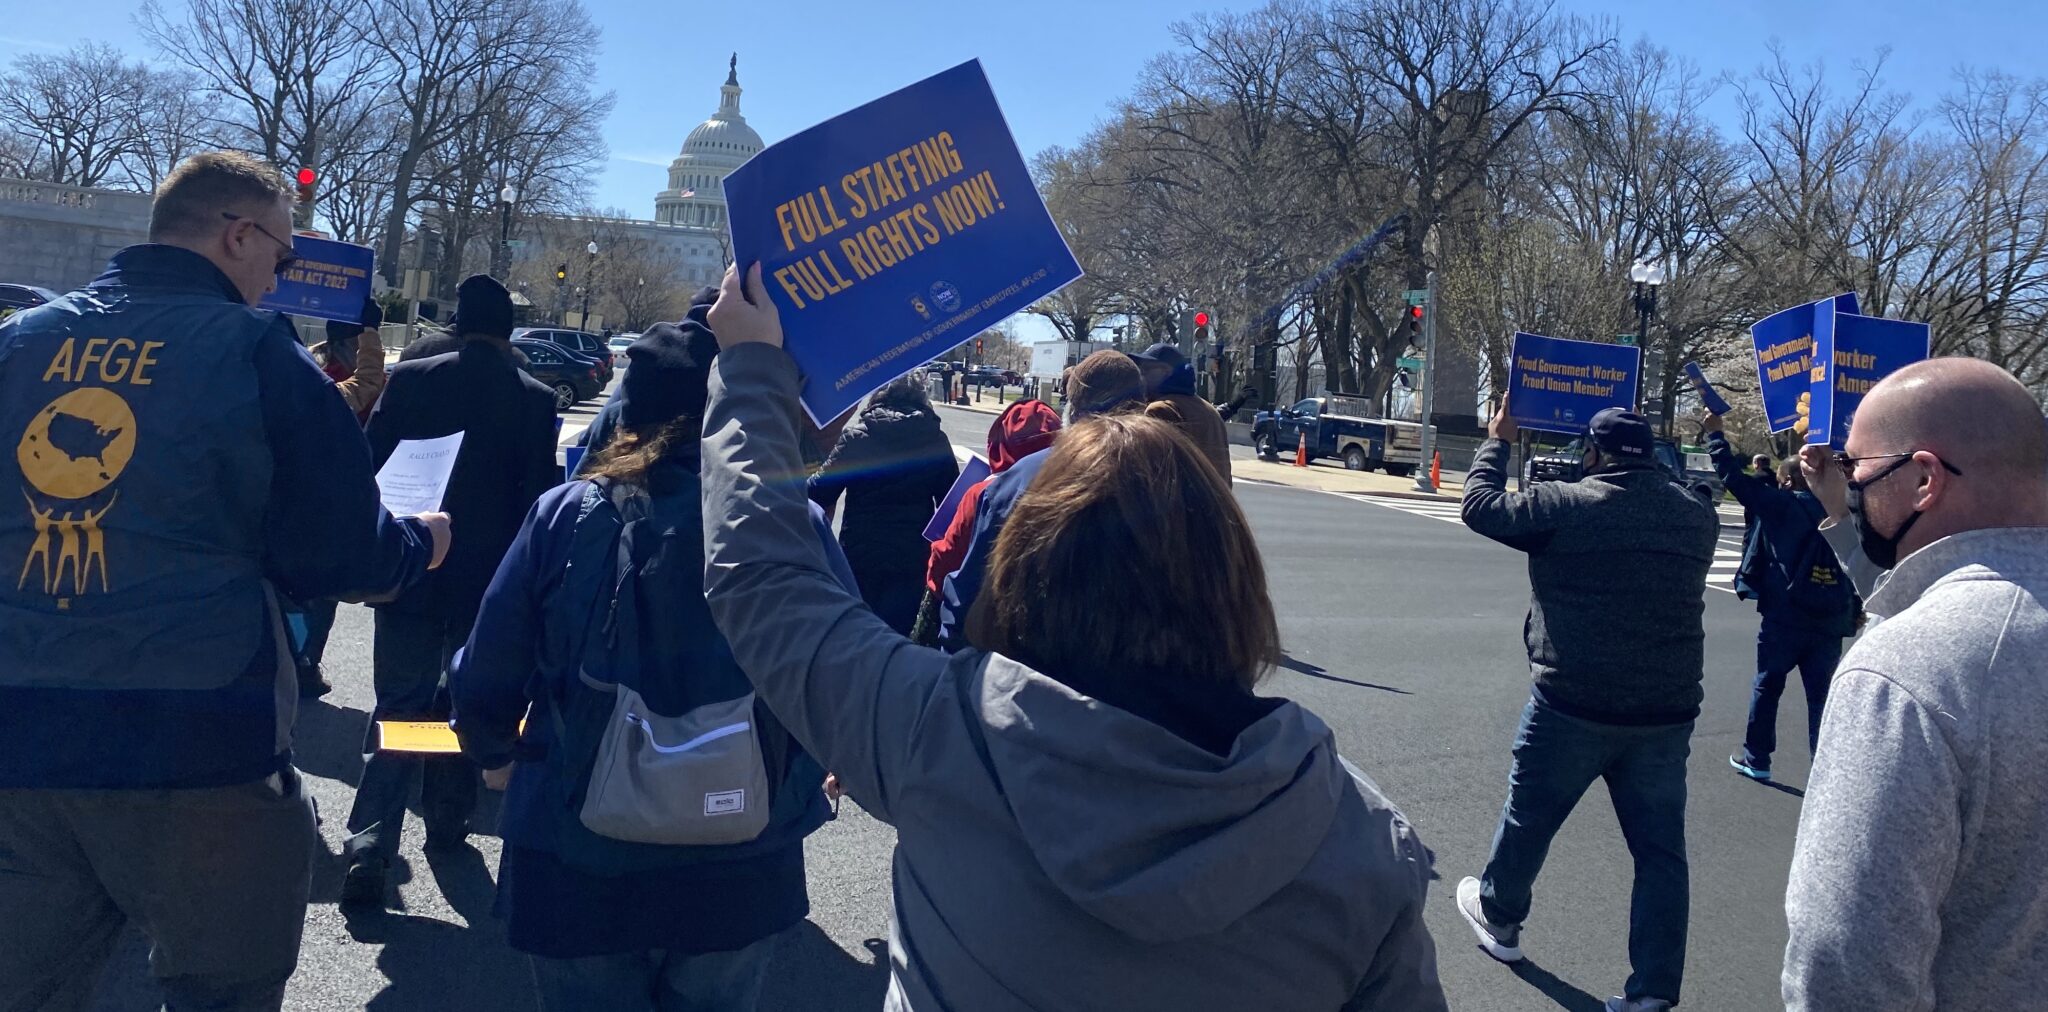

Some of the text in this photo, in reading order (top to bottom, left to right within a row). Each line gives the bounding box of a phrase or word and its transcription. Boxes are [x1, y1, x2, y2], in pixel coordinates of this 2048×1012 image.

[775, 130, 964, 252] FULL STAFFING
[773, 169, 1006, 310] FULL RIGHTS NOW!
[304, 271, 325, 286] ACT
[42, 337, 167, 385] AFGE
[1758, 345, 1774, 365] Proud
[1771, 333, 1813, 360] Government
[835, 357, 881, 391] AMERICAN
[1517, 355, 1628, 382] Proud Government Worker
[1766, 363, 1784, 383] Proud
[1781, 359, 1801, 378] Union
[1522, 373, 1614, 398] Proud Union Member!
